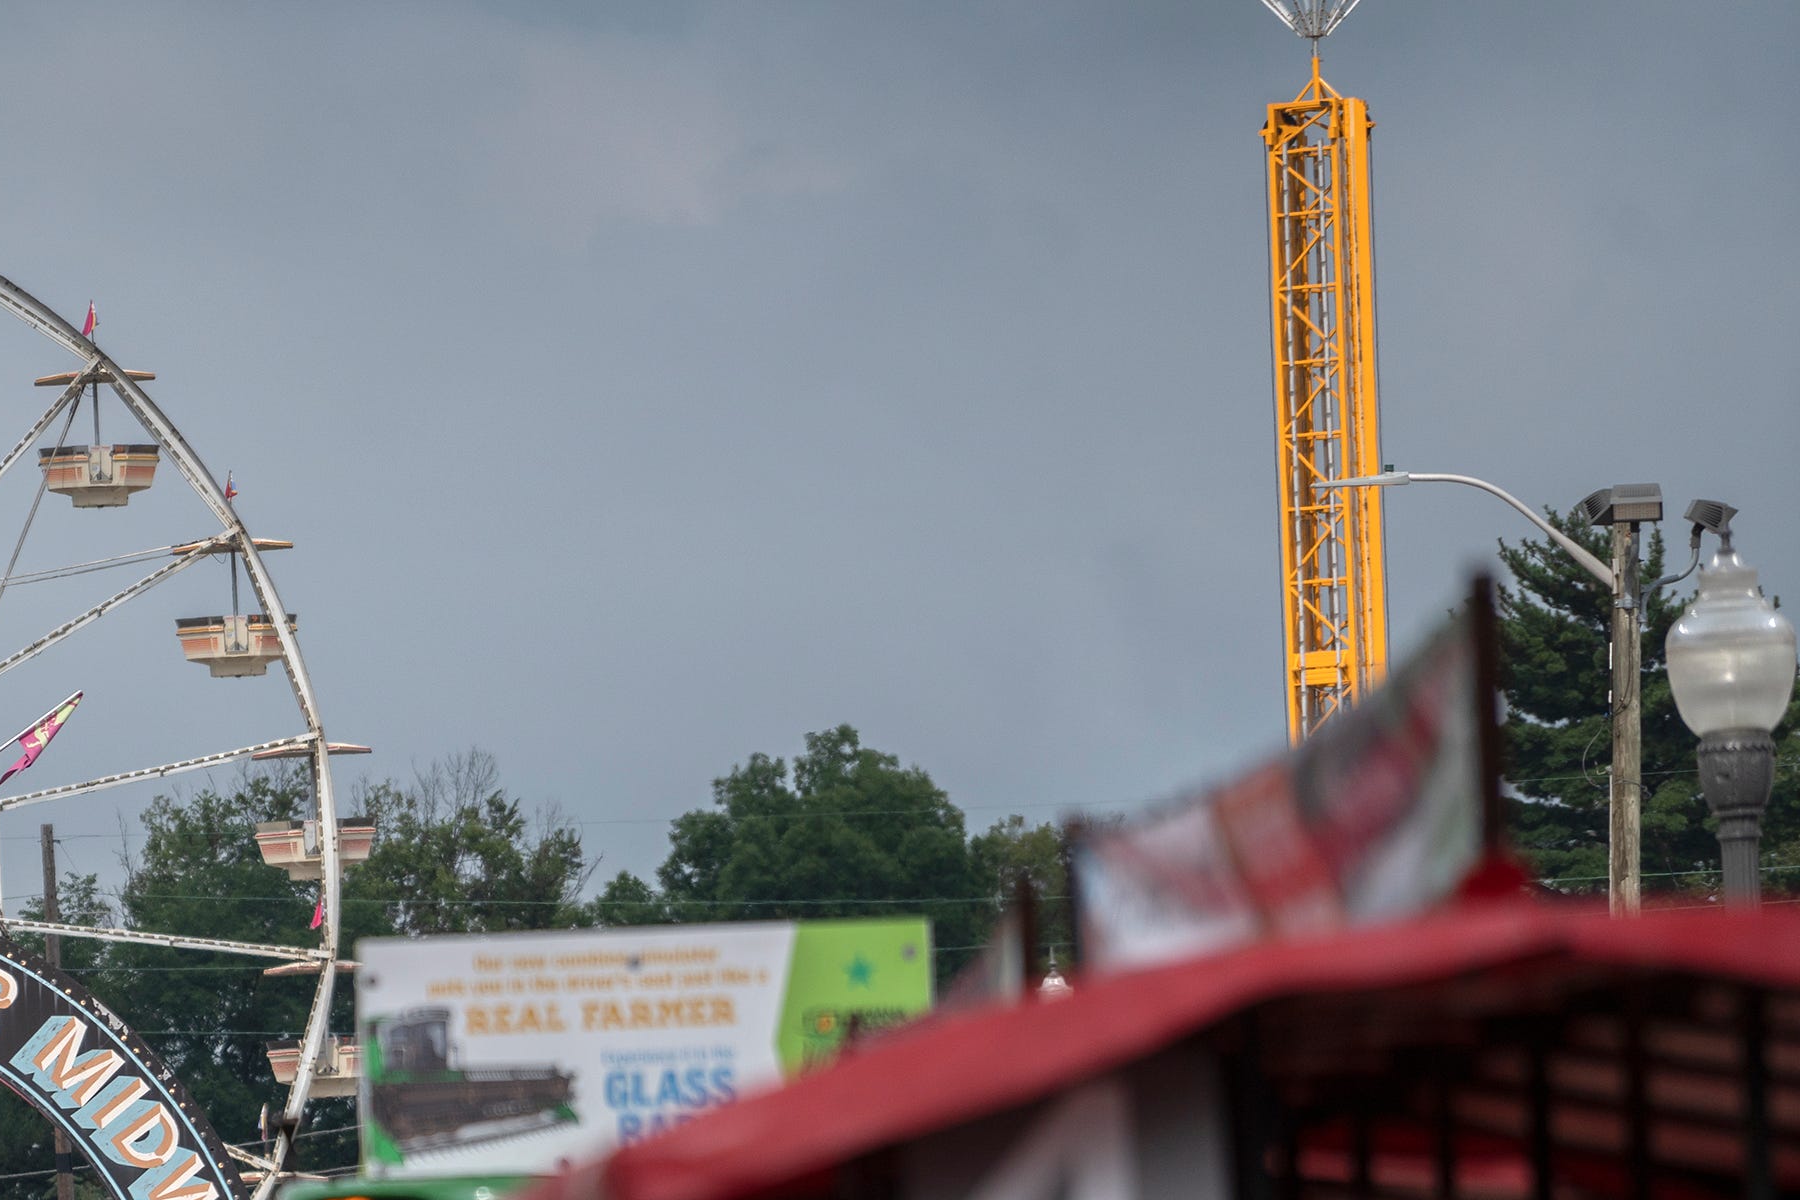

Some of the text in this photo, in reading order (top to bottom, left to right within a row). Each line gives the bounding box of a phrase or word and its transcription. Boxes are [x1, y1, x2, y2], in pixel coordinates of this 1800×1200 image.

[463, 995, 737, 1036] REAL FARMER
[603, 1067, 737, 1110] GLASS
